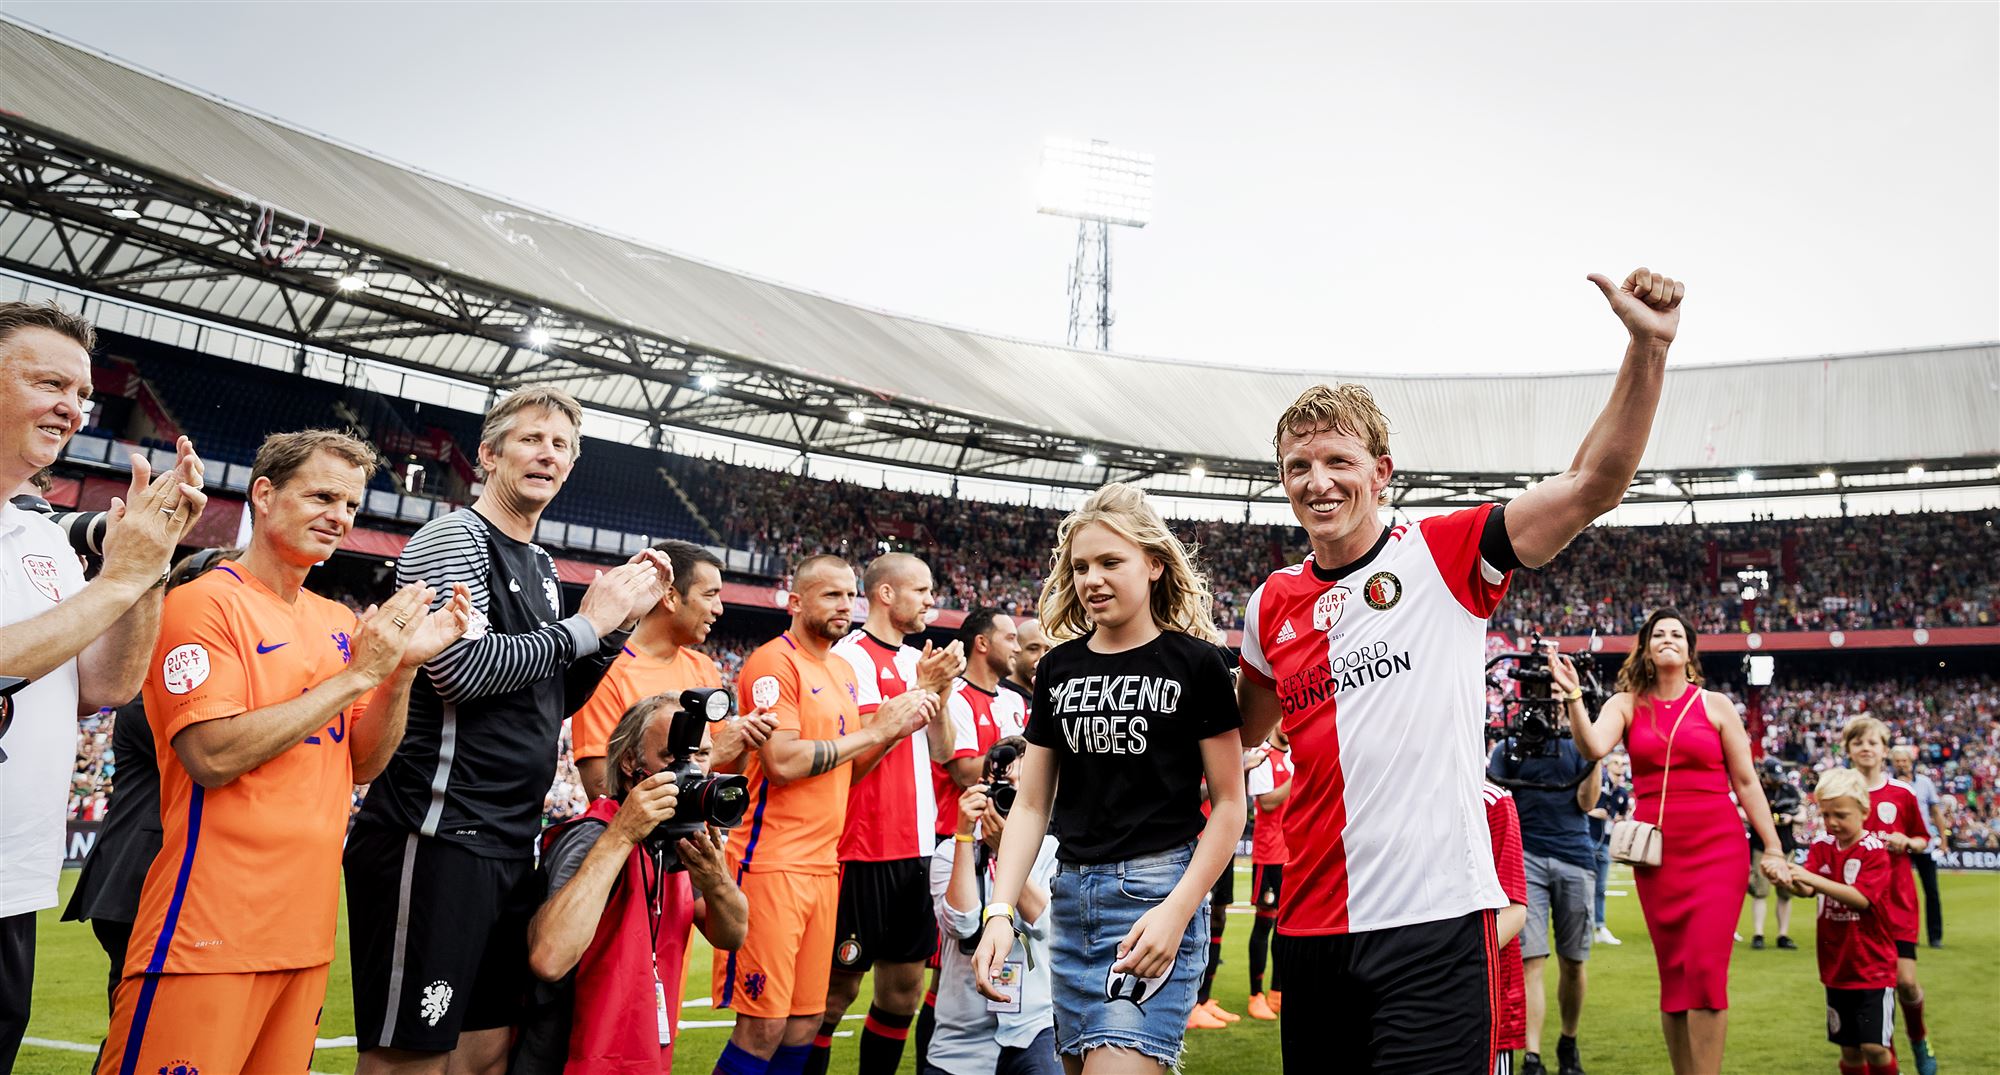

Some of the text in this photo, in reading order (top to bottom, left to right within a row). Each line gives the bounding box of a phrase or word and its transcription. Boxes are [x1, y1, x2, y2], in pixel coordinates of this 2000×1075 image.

[1319, 592, 1347, 605] DIRK
[1318, 602, 1340, 614] KUY
[1276, 631, 1297, 645] adidas
[168, 649, 198, 666] DIRK
[168, 657, 200, 674] KUYT
[1283, 641, 1388, 695] FEYENOORD
[1049, 675, 1182, 716] WEEKEND
[1061, 715, 1149, 755] VIBES
